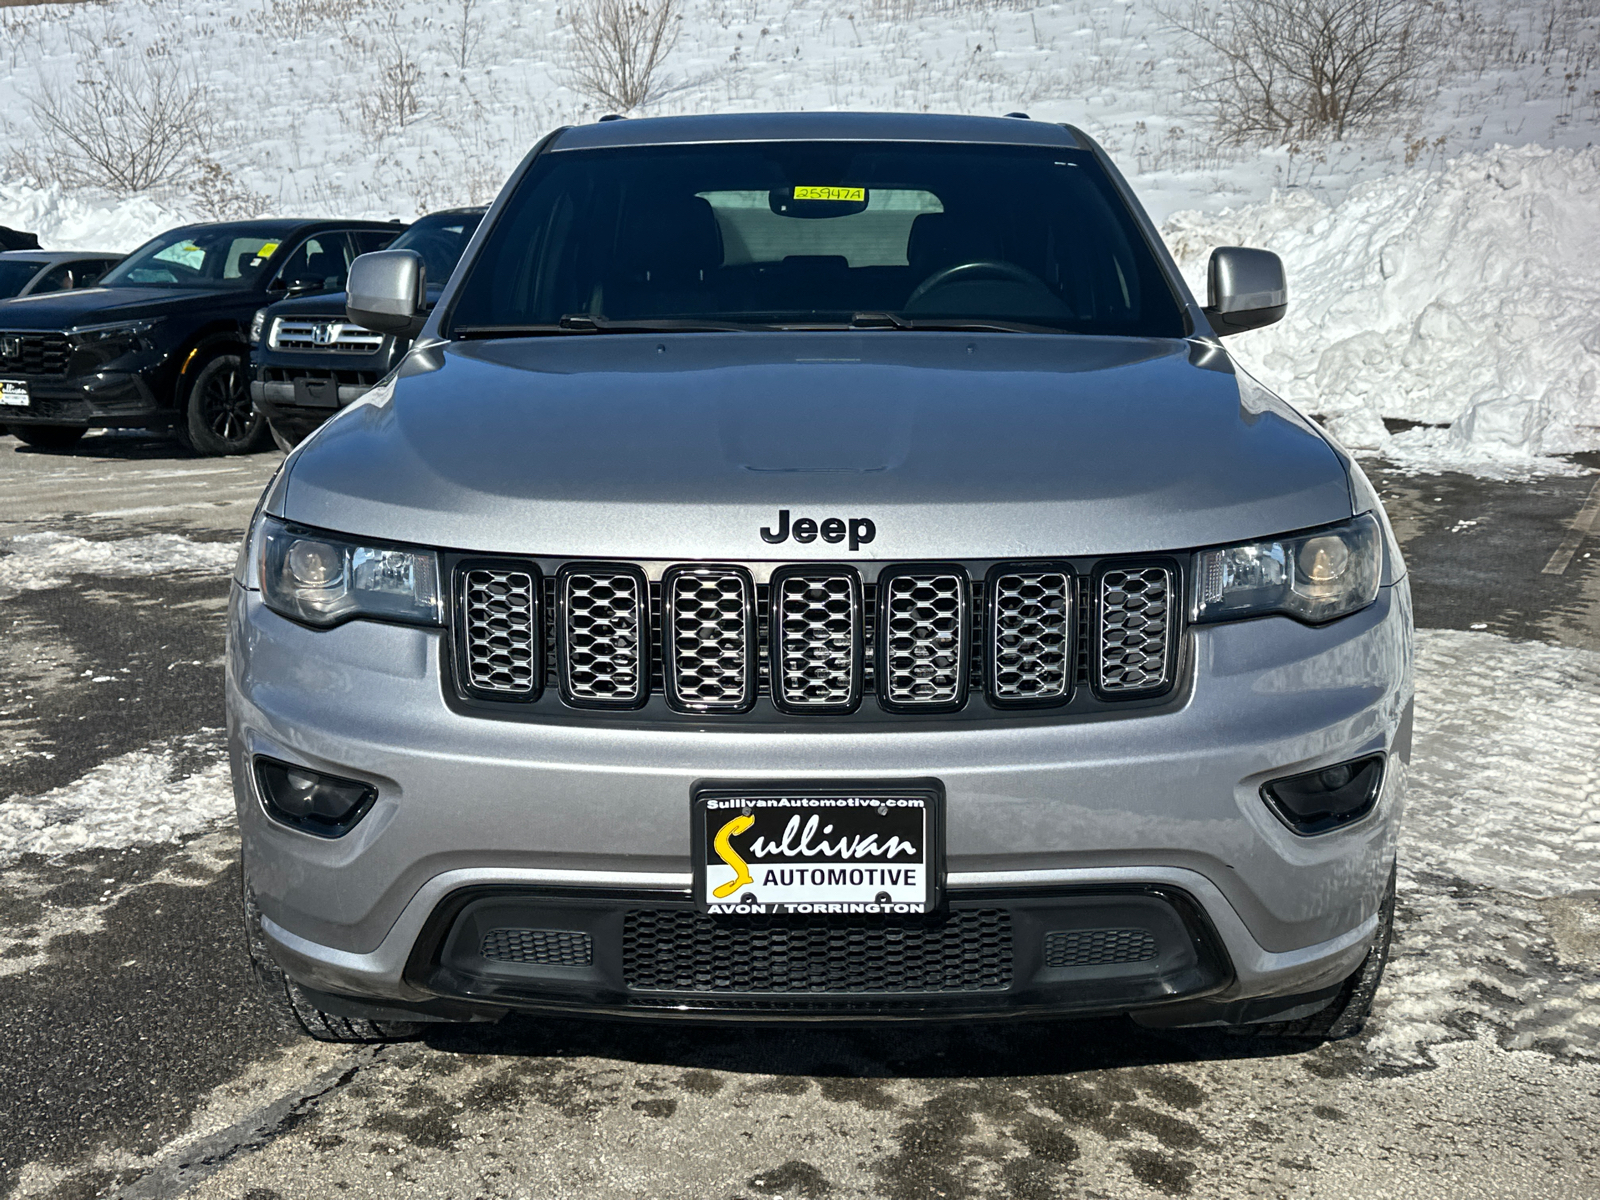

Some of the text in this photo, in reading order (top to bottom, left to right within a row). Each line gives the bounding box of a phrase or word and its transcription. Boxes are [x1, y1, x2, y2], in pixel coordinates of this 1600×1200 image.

[796, 188, 862, 199] 25947A
[760, 509, 876, 551] Jeep
[707, 798, 924, 810] SullivanAutomotive.com
[712, 814, 917, 898] Sullivan
[763, 868, 916, 886] AUTOMOTIVE
[707, 903, 766, 914] AVON
[784, 903, 925, 914] TORRINGTON
